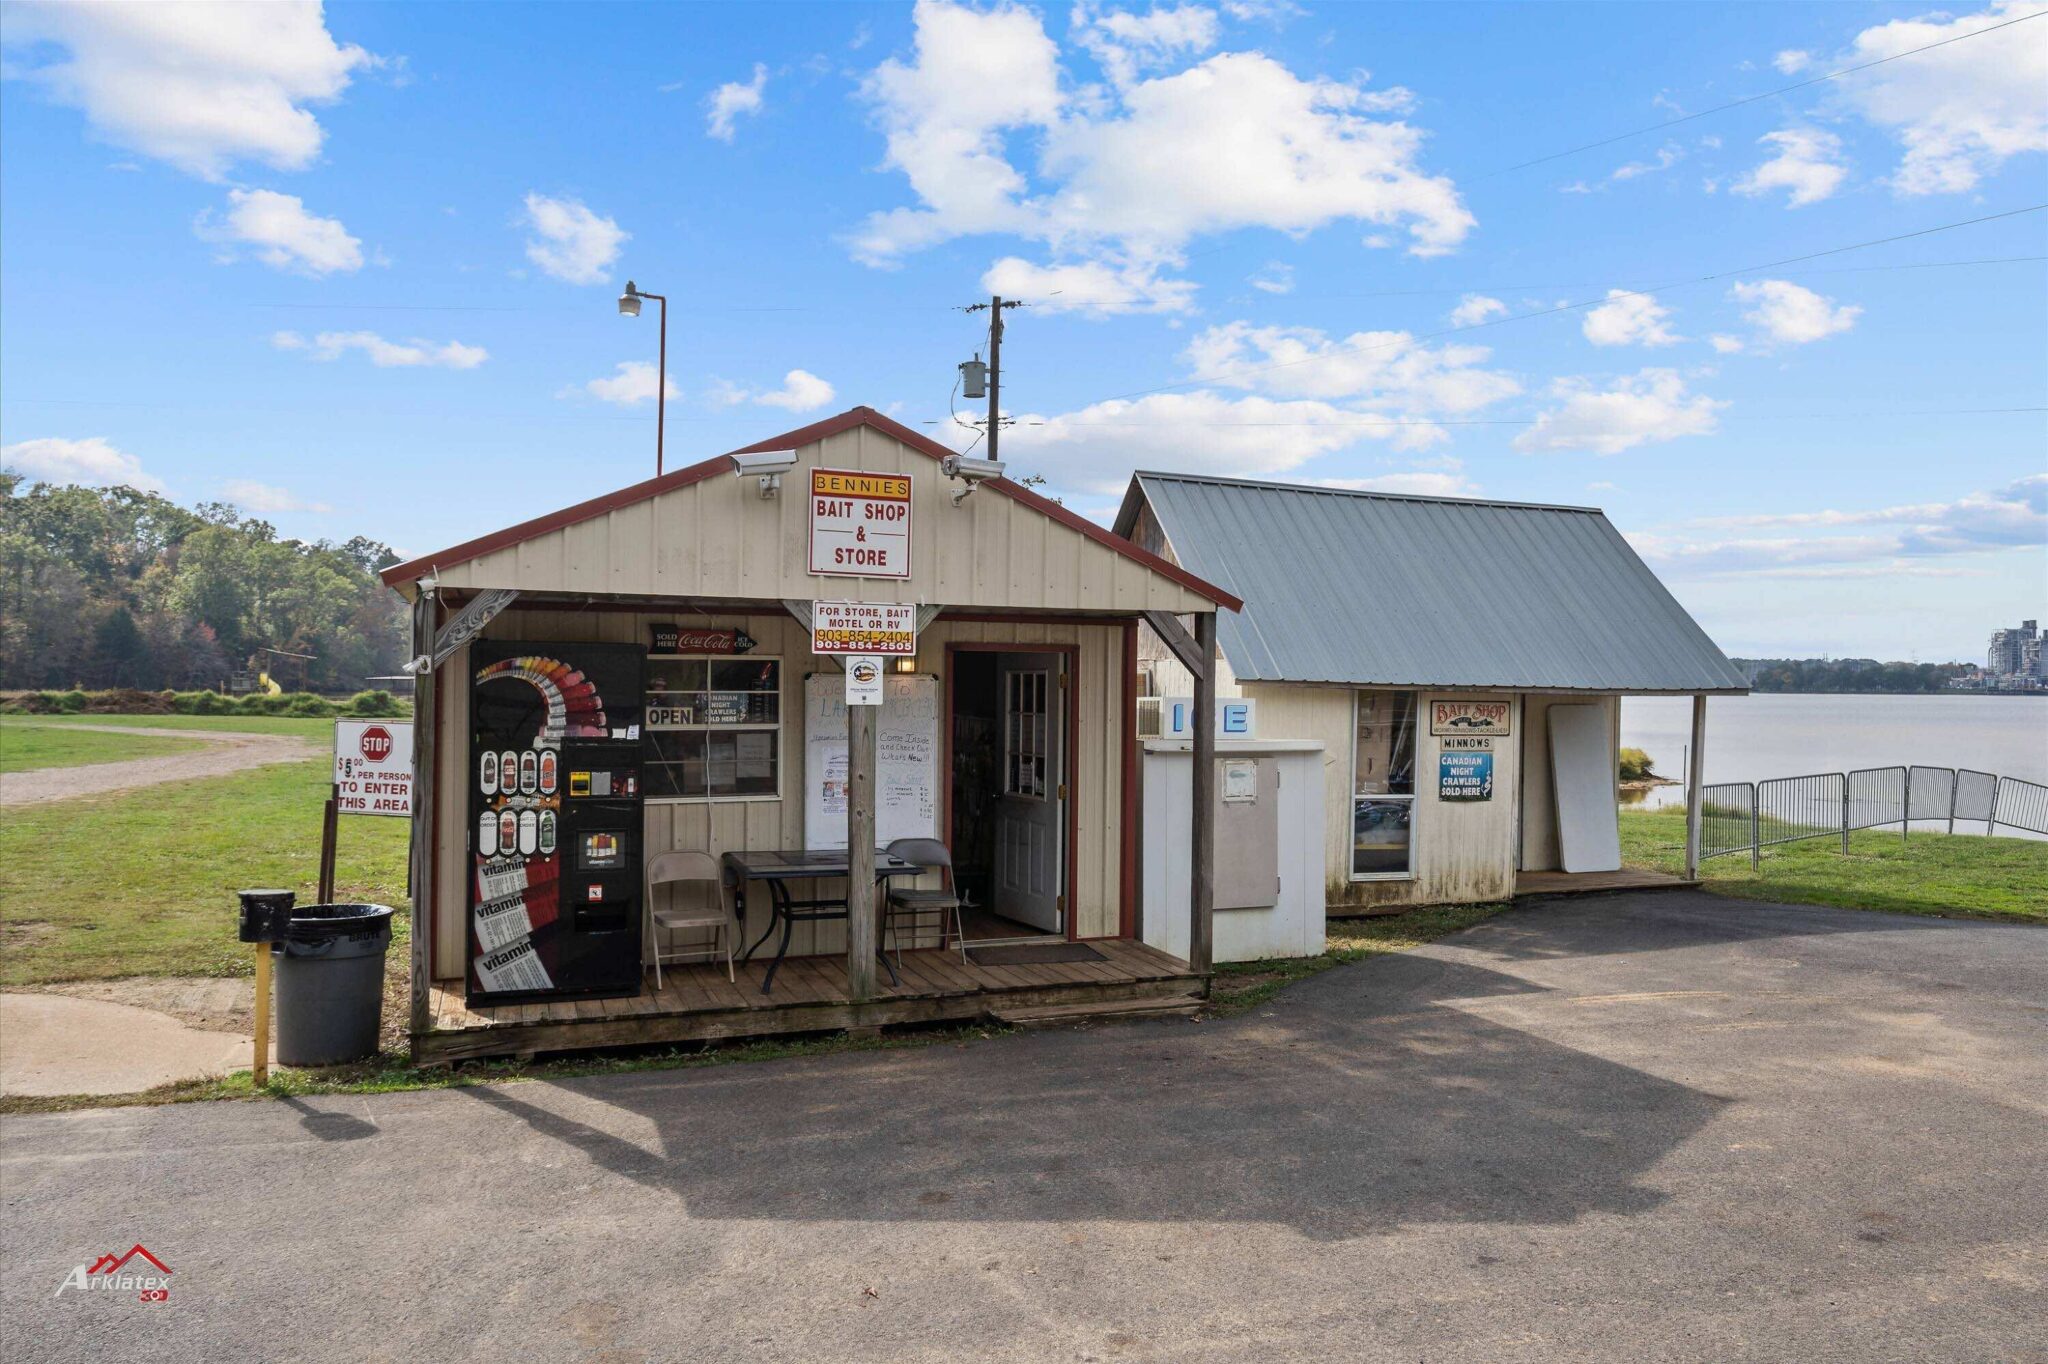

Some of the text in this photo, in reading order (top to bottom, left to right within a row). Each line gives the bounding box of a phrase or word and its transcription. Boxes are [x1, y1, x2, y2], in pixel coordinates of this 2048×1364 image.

[816, 477, 908, 495] BENNIES
[816, 500, 906, 521] BAIT SHOP
[856, 526, 866, 542] &
[834, 548, 887, 566] STORE
[819, 607, 910, 618] FOR STORE, BAIT
[829, 618, 900, 630] MOTEL OR RV
[818, 630, 911, 644] 903-854-2404
[816, 641, 912, 651] 903-854-2505
[648, 709, 692, 724] OPEN
[1173, 704, 1248, 732] IE
[1436, 704, 1470, 724] BAIT
[1472, 704, 1506, 722] SHOP
[363, 737, 390, 752] STOP
[1444, 738, 1490, 748] MINNOWS
[1442, 757, 1482, 765] CANADIAN
[358, 771, 374, 780] PER
[378, 772, 412, 781] PERSON
[1450, 768, 1474, 776] NIGHT
[340, 781, 408, 796] TO ENTER
[1442, 778, 1480, 786] CRAWLERS
[1442, 787, 1480, 796] SOLD HERE
[338, 797, 409, 811] THIS AREA
[482, 860, 524, 876] vitamin
[477, 894, 524, 918] vitamin
